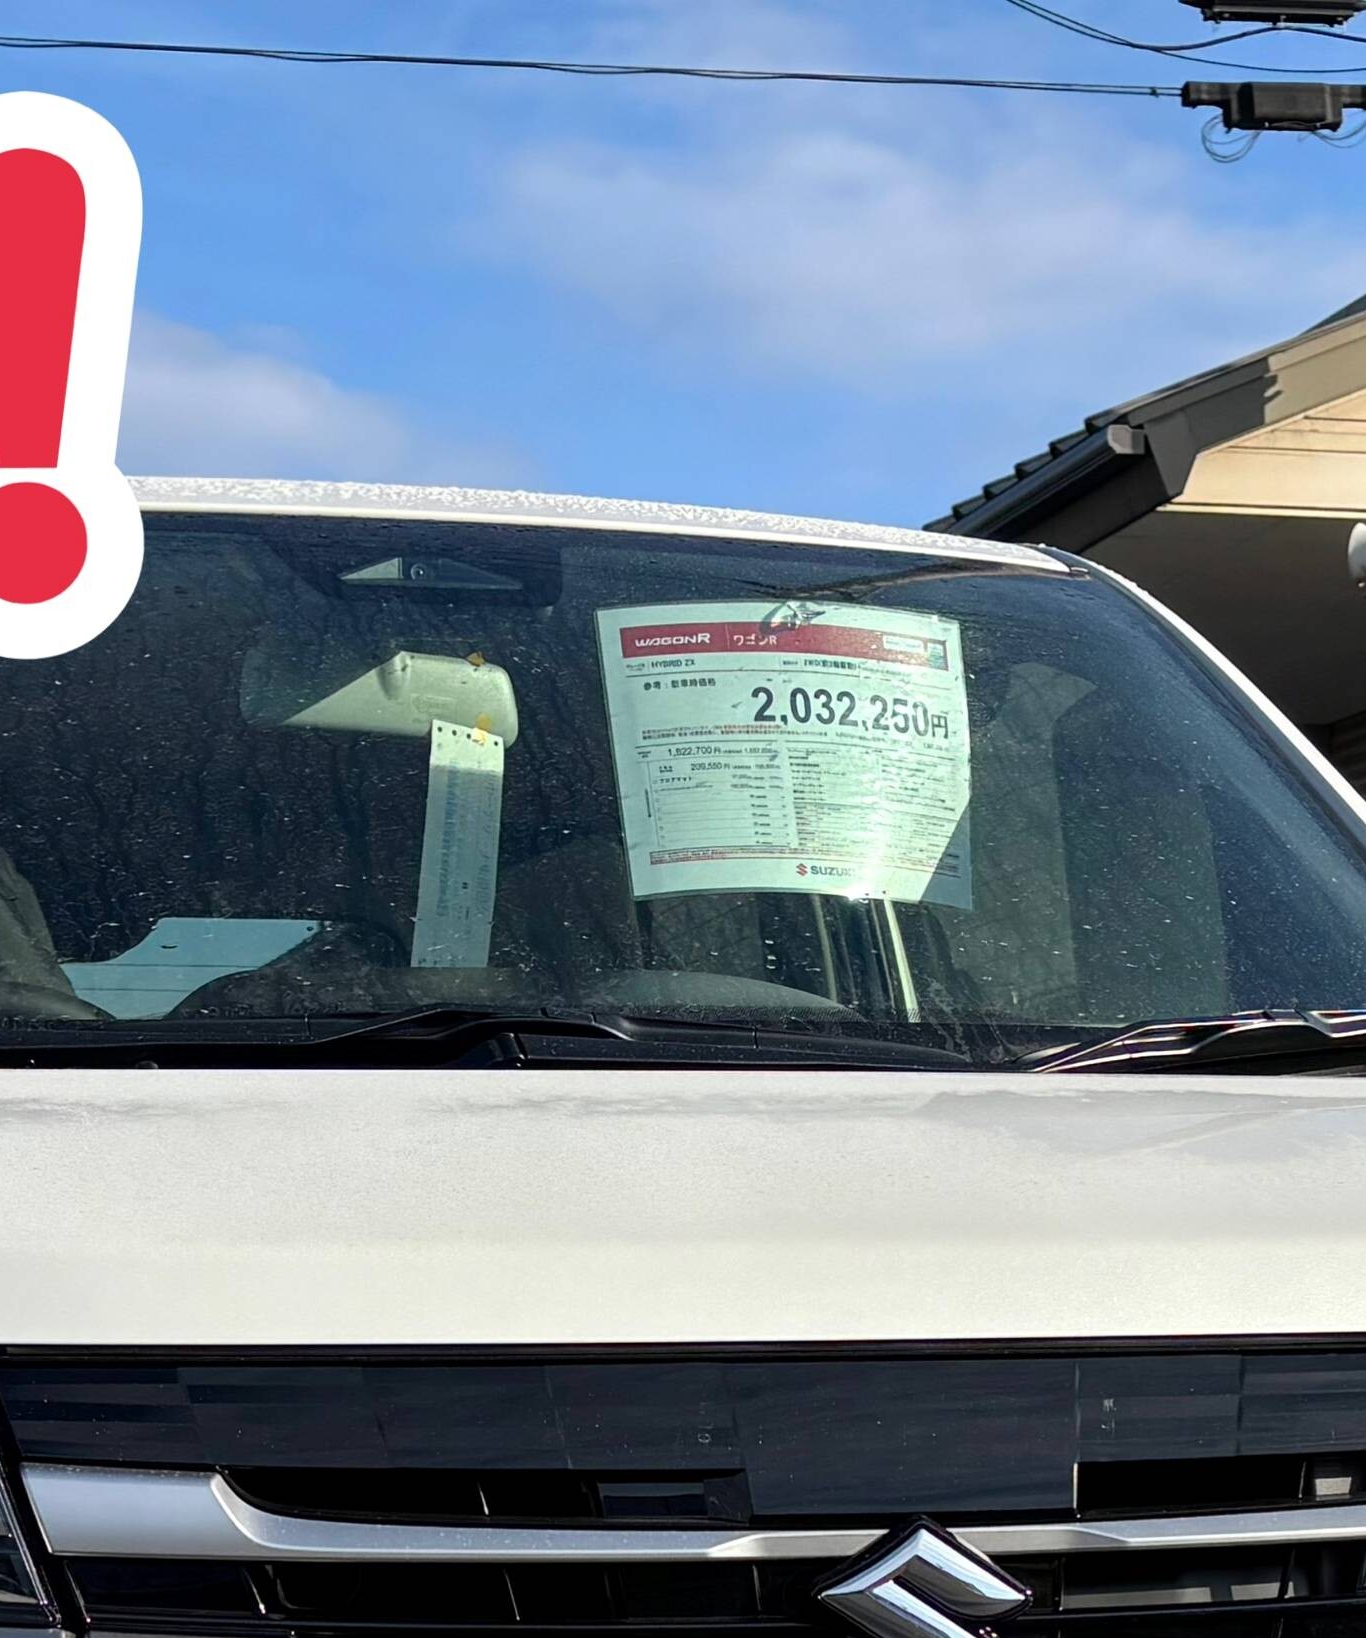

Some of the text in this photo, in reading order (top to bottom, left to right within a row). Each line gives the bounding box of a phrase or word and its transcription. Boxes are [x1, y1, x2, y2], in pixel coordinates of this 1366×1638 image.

[733, 634, 778, 647] ワゴンR
[651, 659, 683, 669] HYBRID
[751, 686, 949, 740] 2,032,250円
[810, 864, 855, 877] SUZUK
